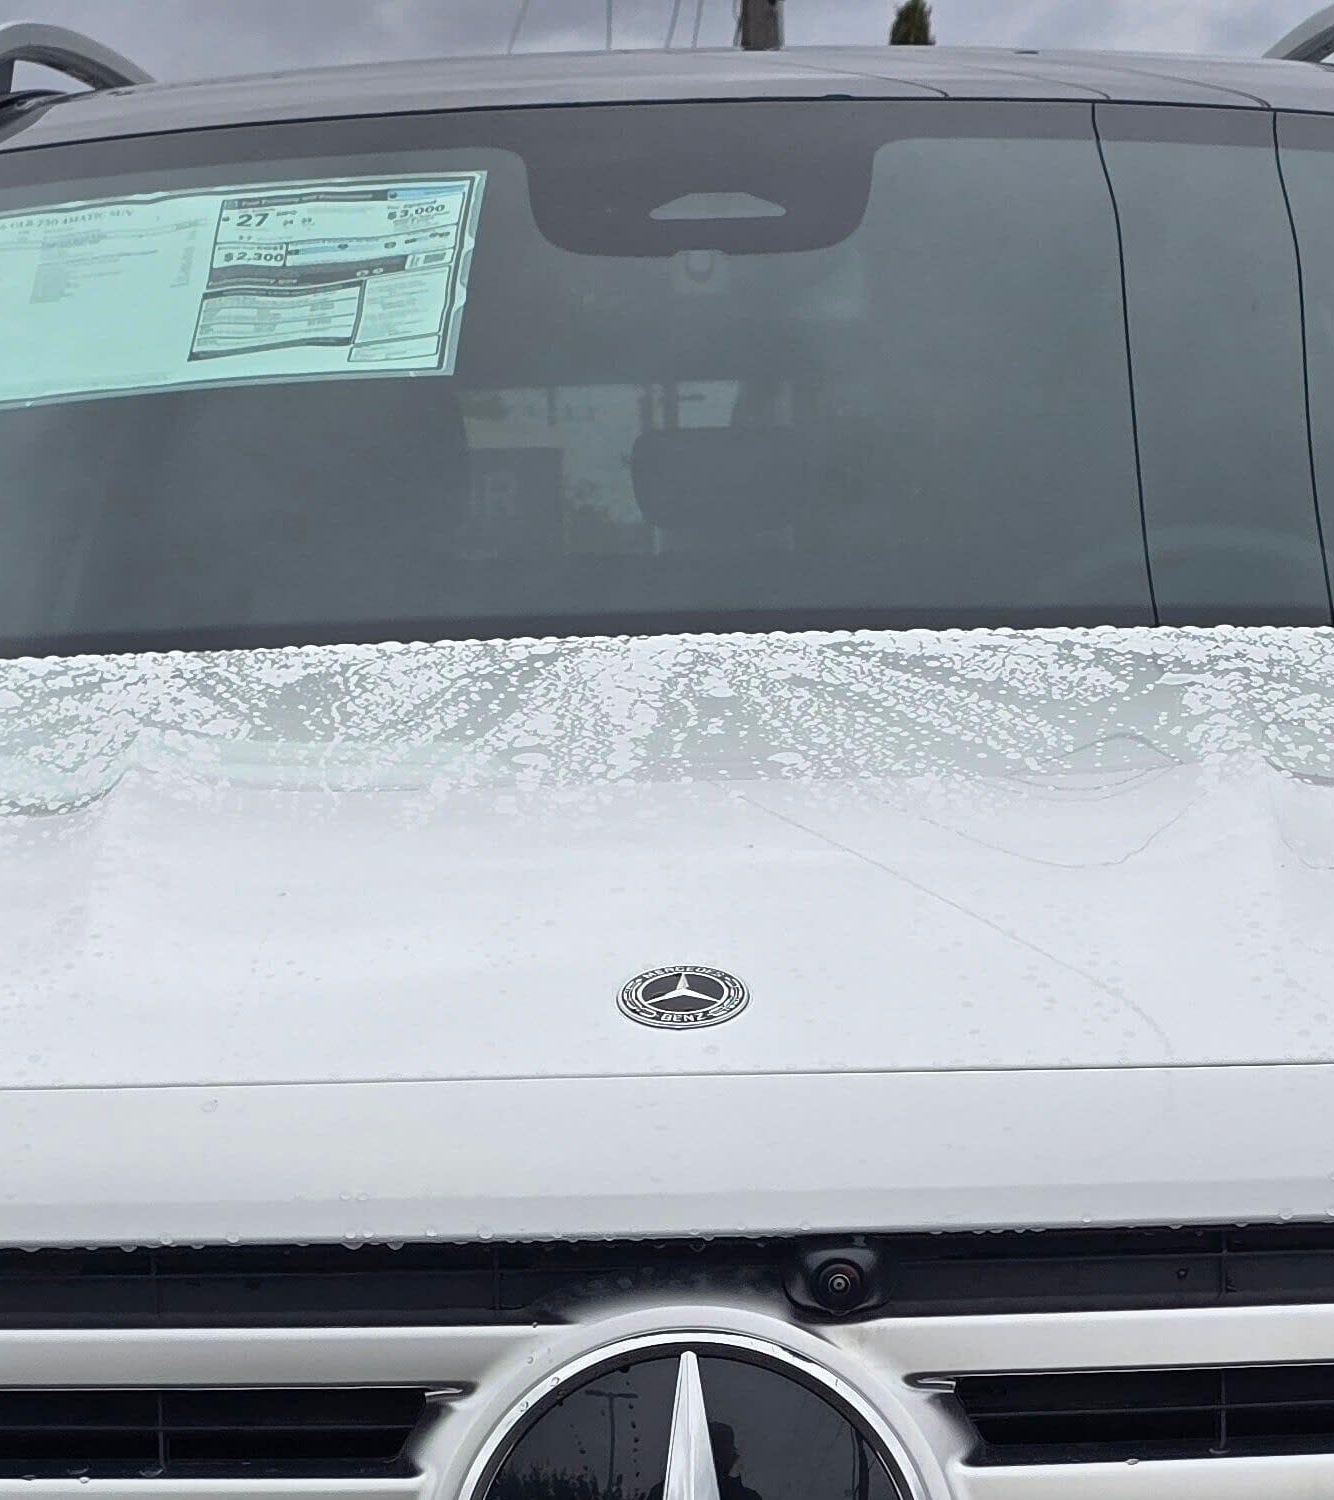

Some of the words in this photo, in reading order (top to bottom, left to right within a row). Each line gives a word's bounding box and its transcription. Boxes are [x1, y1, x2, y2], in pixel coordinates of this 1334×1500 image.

[236, 213, 269, 228] 27
[642, 966, 724, 979] MERCEDES
[660, 1012, 707, 1022] BENZ
